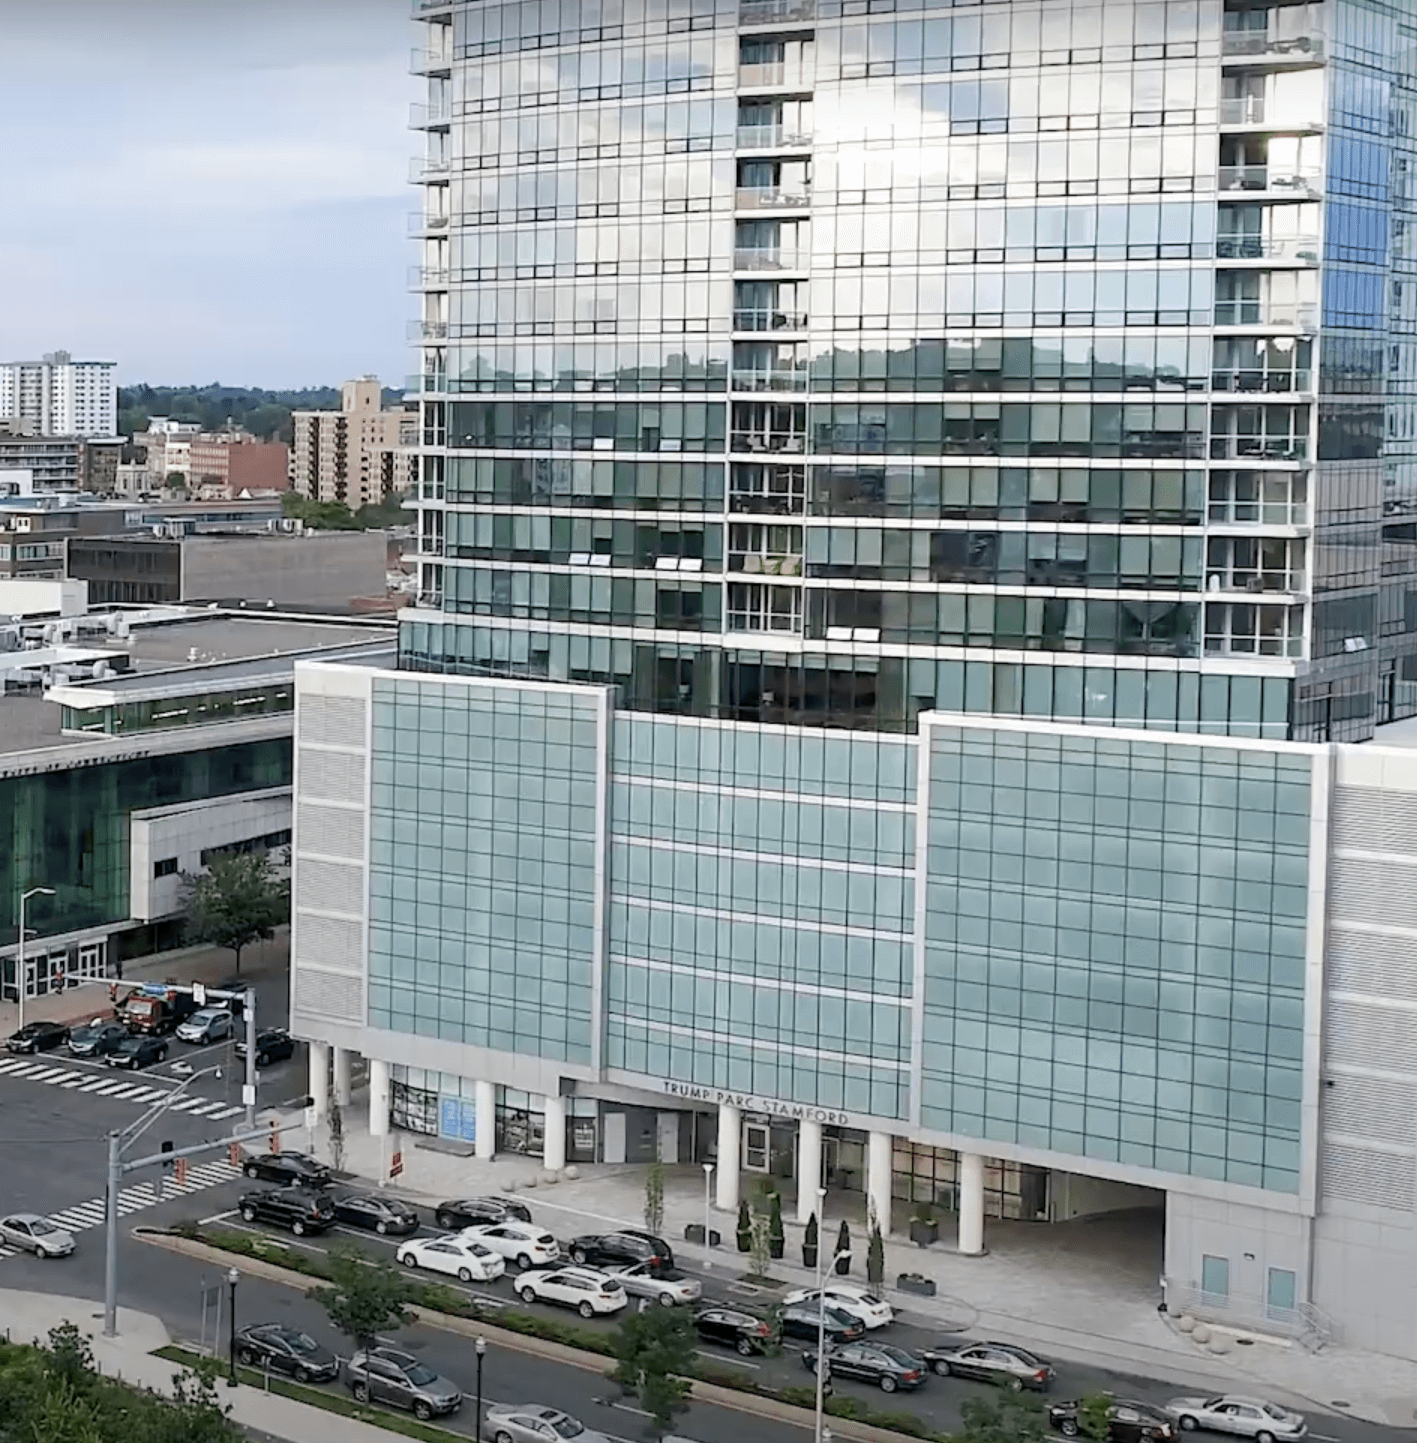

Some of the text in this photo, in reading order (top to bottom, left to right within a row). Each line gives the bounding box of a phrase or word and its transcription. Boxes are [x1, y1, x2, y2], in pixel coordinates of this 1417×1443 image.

[664, 1080, 849, 1125] TRUMP PARC STAMFORD
